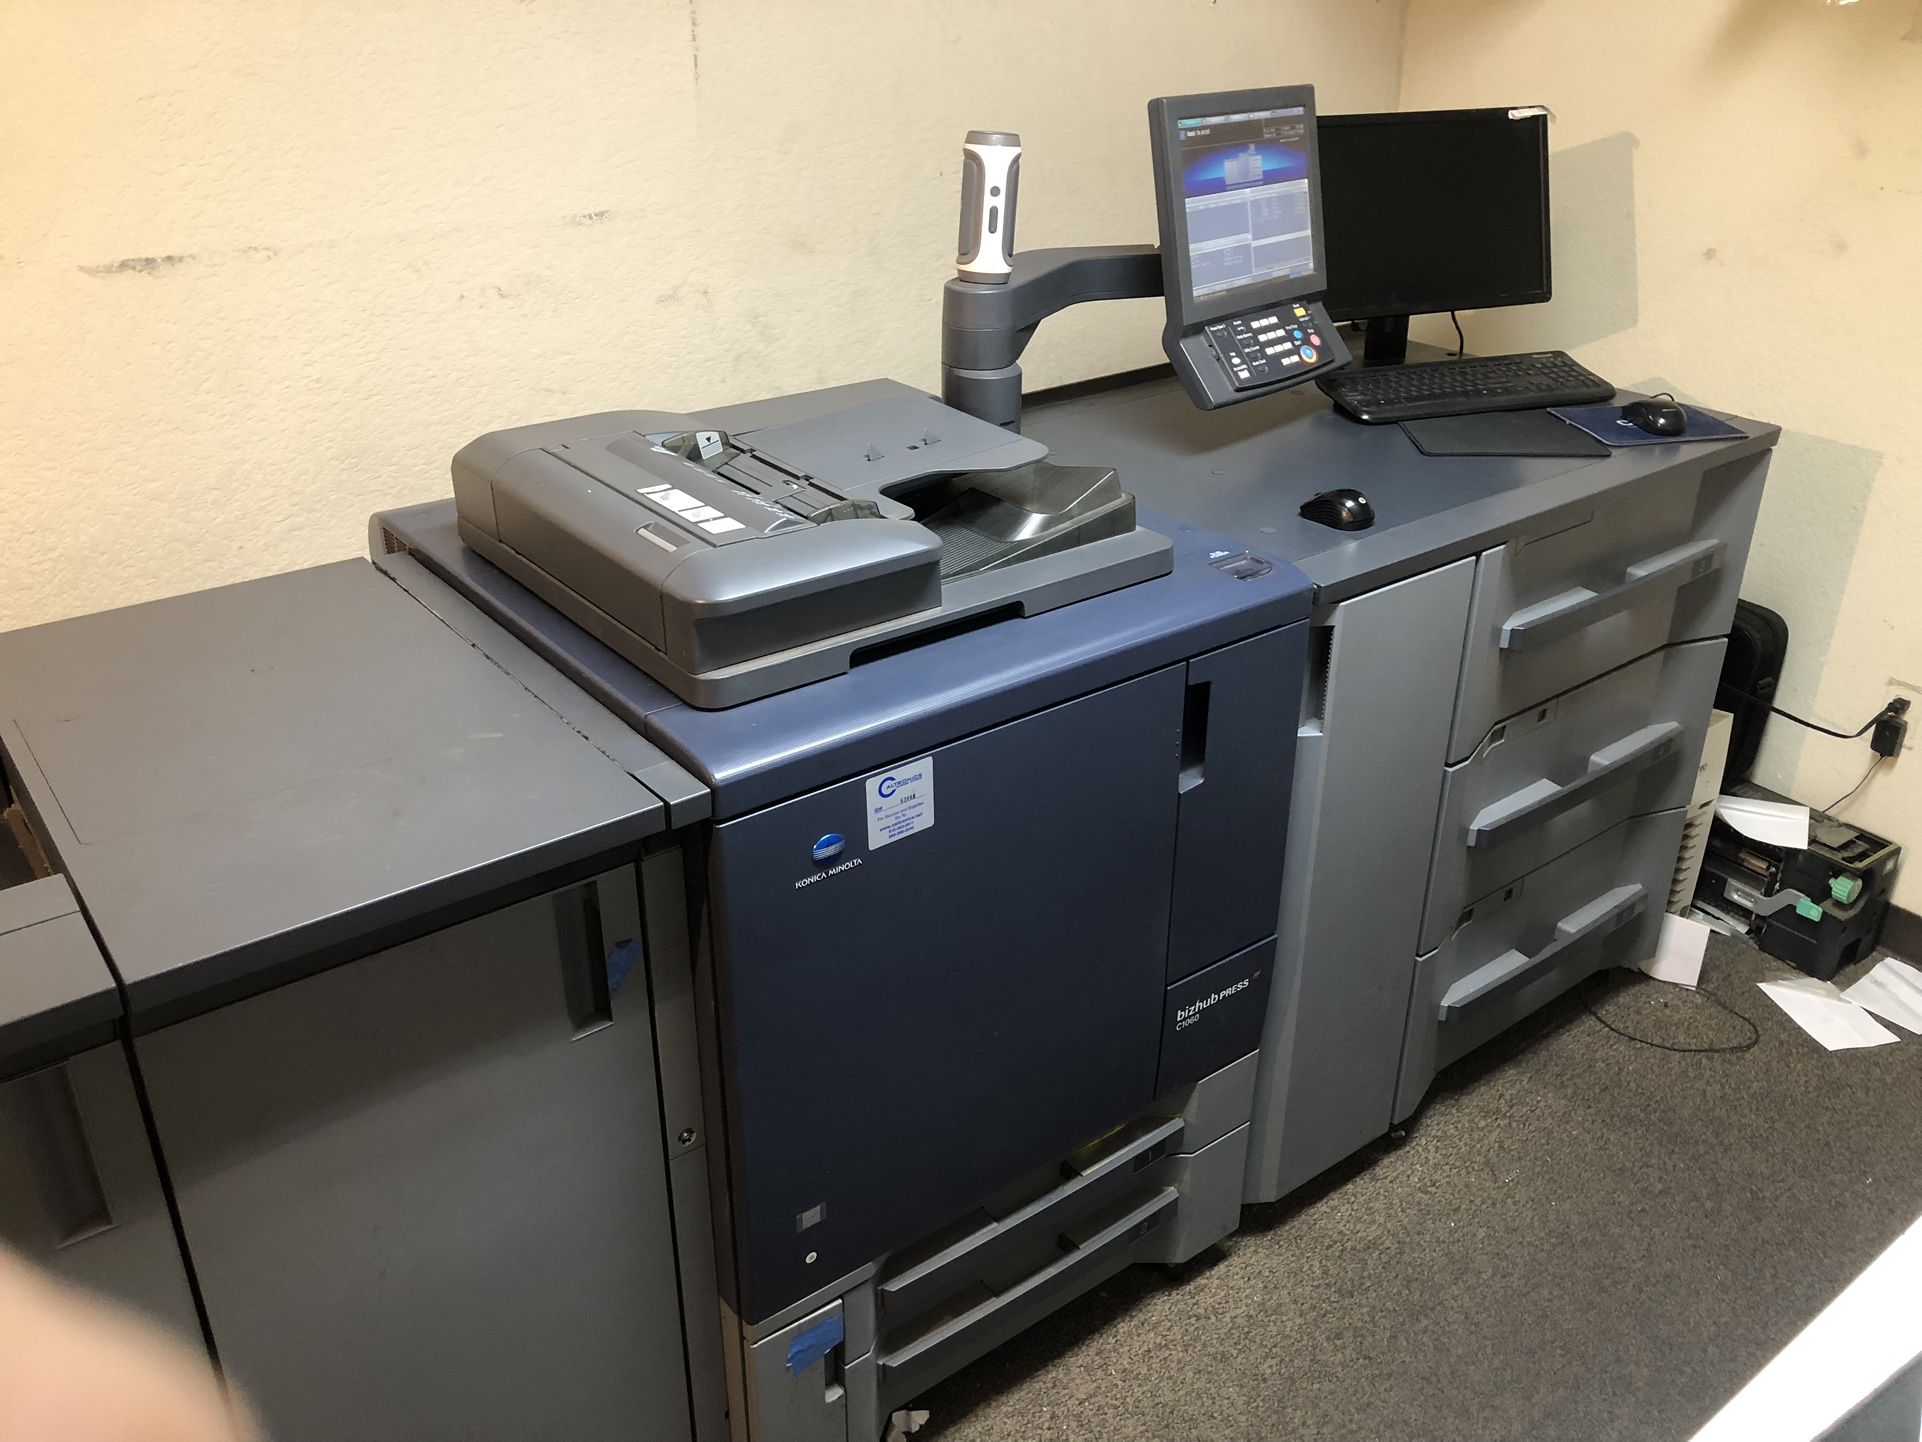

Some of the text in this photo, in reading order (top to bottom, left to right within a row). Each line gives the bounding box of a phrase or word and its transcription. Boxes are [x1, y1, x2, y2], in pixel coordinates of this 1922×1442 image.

[795, 858, 863, 889] KONICA MINOLTA
[1176, 978, 1250, 1022] bizhub PRESS
[1175, 1013, 1200, 1031] C1060
